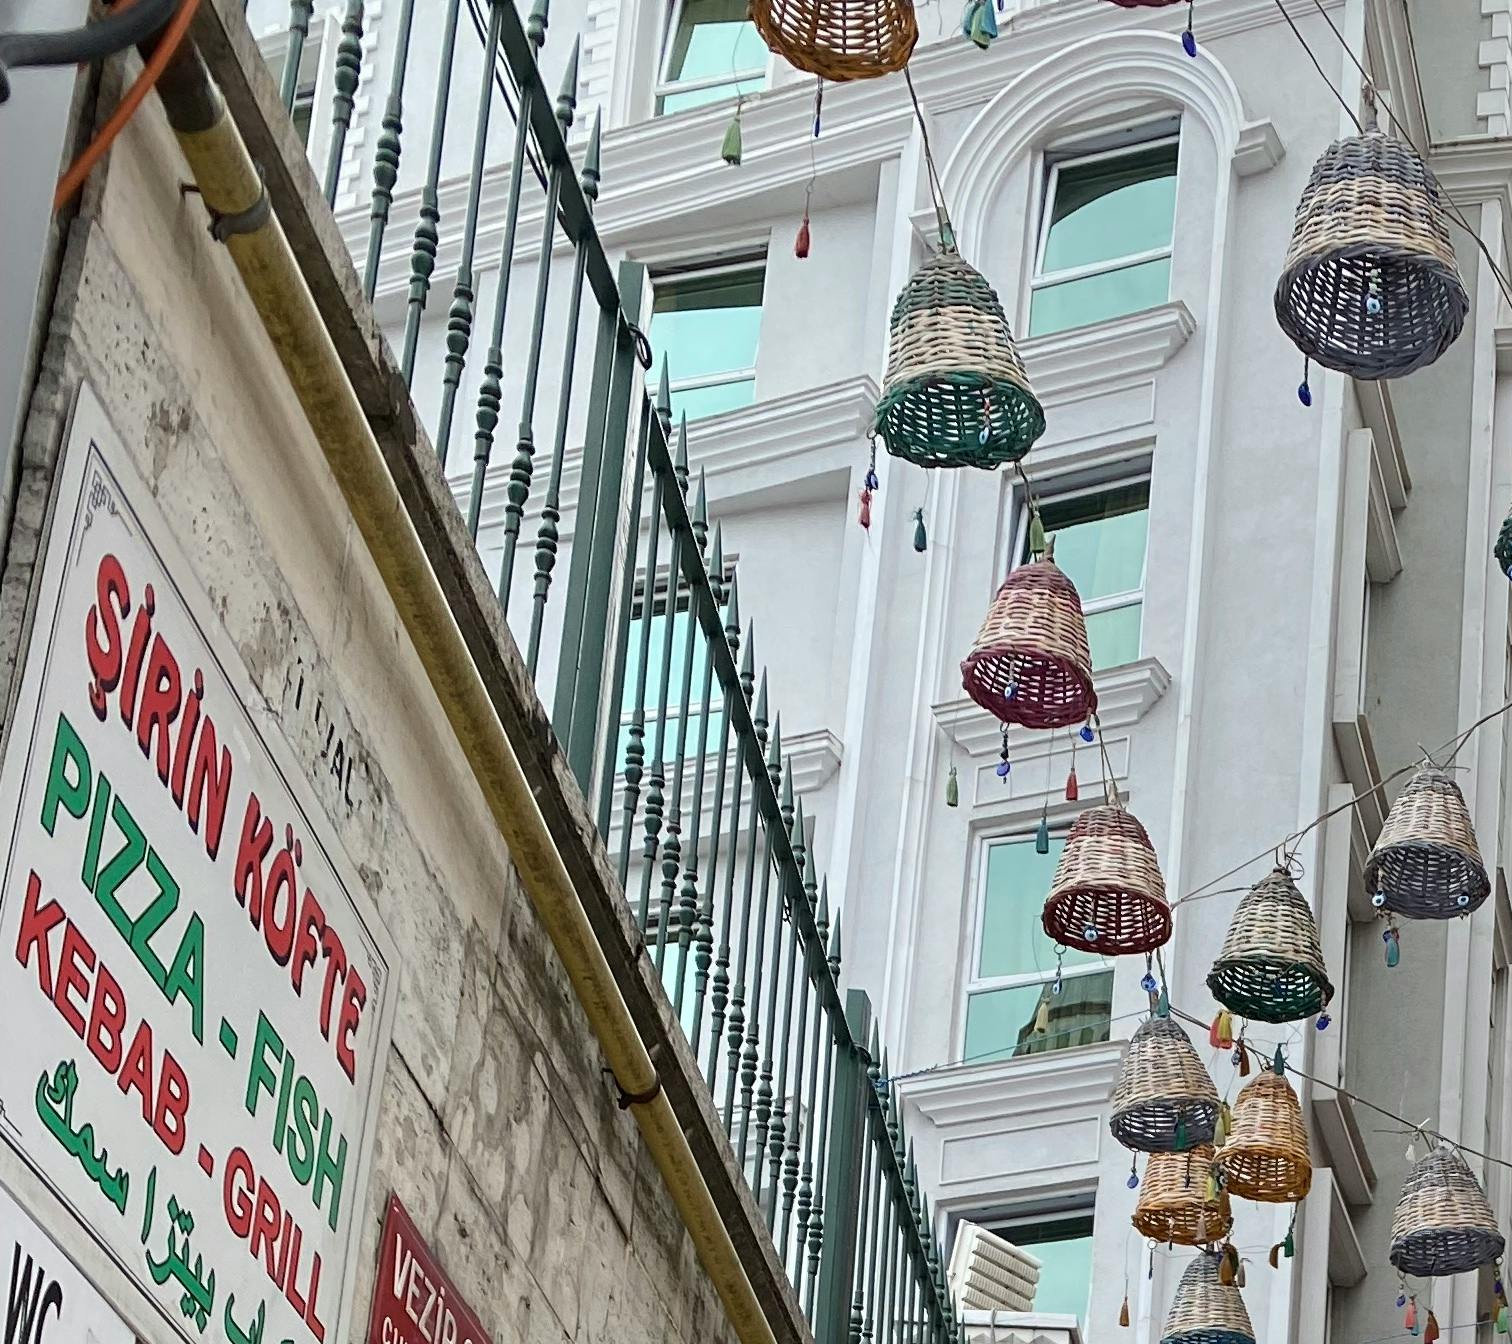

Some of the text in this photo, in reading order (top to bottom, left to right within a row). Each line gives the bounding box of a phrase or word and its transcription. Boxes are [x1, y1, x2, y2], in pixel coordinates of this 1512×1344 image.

[15, 868, 190, 1156] KEBAB
[41, 711, 204, 1047] PIZZA
[245, 1008, 348, 1233] FISH
[85, 553, 233, 862] ŞİRİN
[234, 791, 367, 1086] KÖFTE
